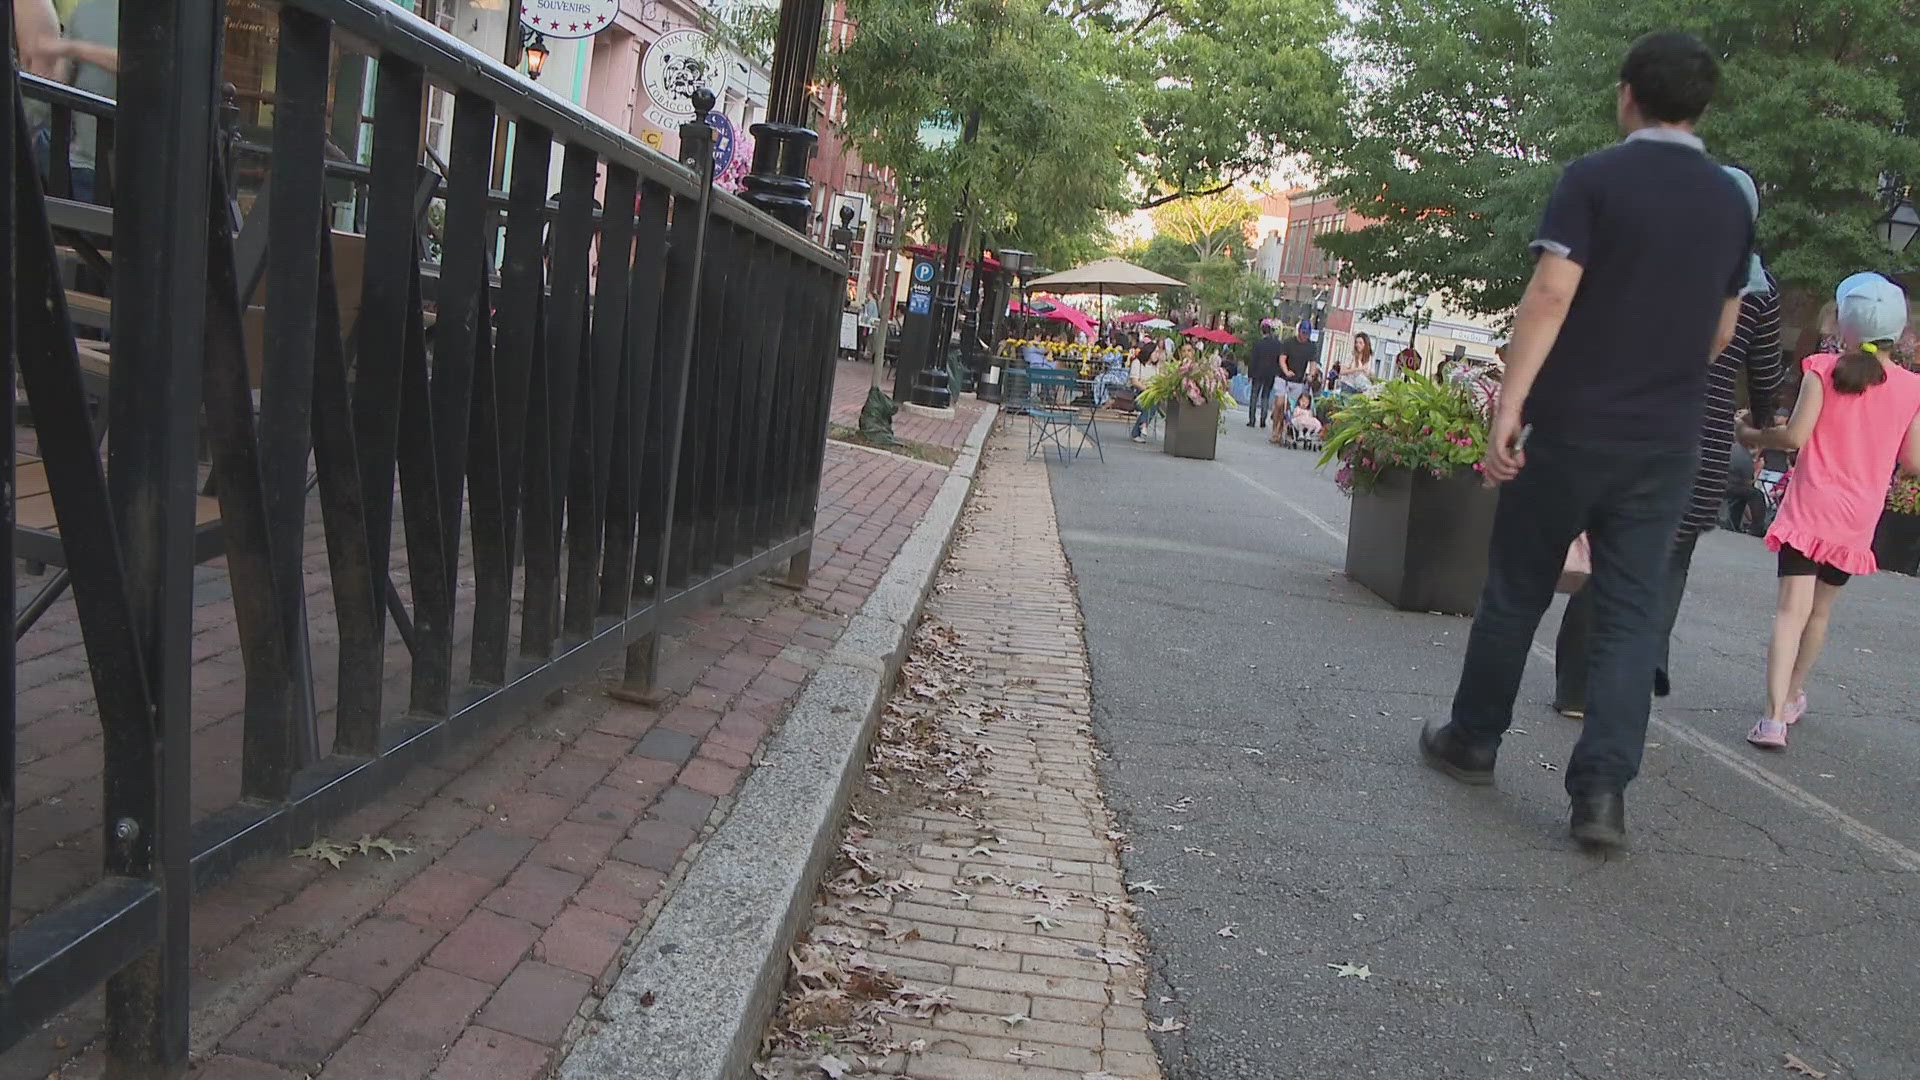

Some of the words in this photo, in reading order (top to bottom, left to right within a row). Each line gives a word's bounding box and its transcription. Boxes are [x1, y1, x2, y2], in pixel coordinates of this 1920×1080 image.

[537, 0, 591, 14] SOUVENIRS
[656, 34, 682, 53] JOHN
[920, 265, 930, 279] P
